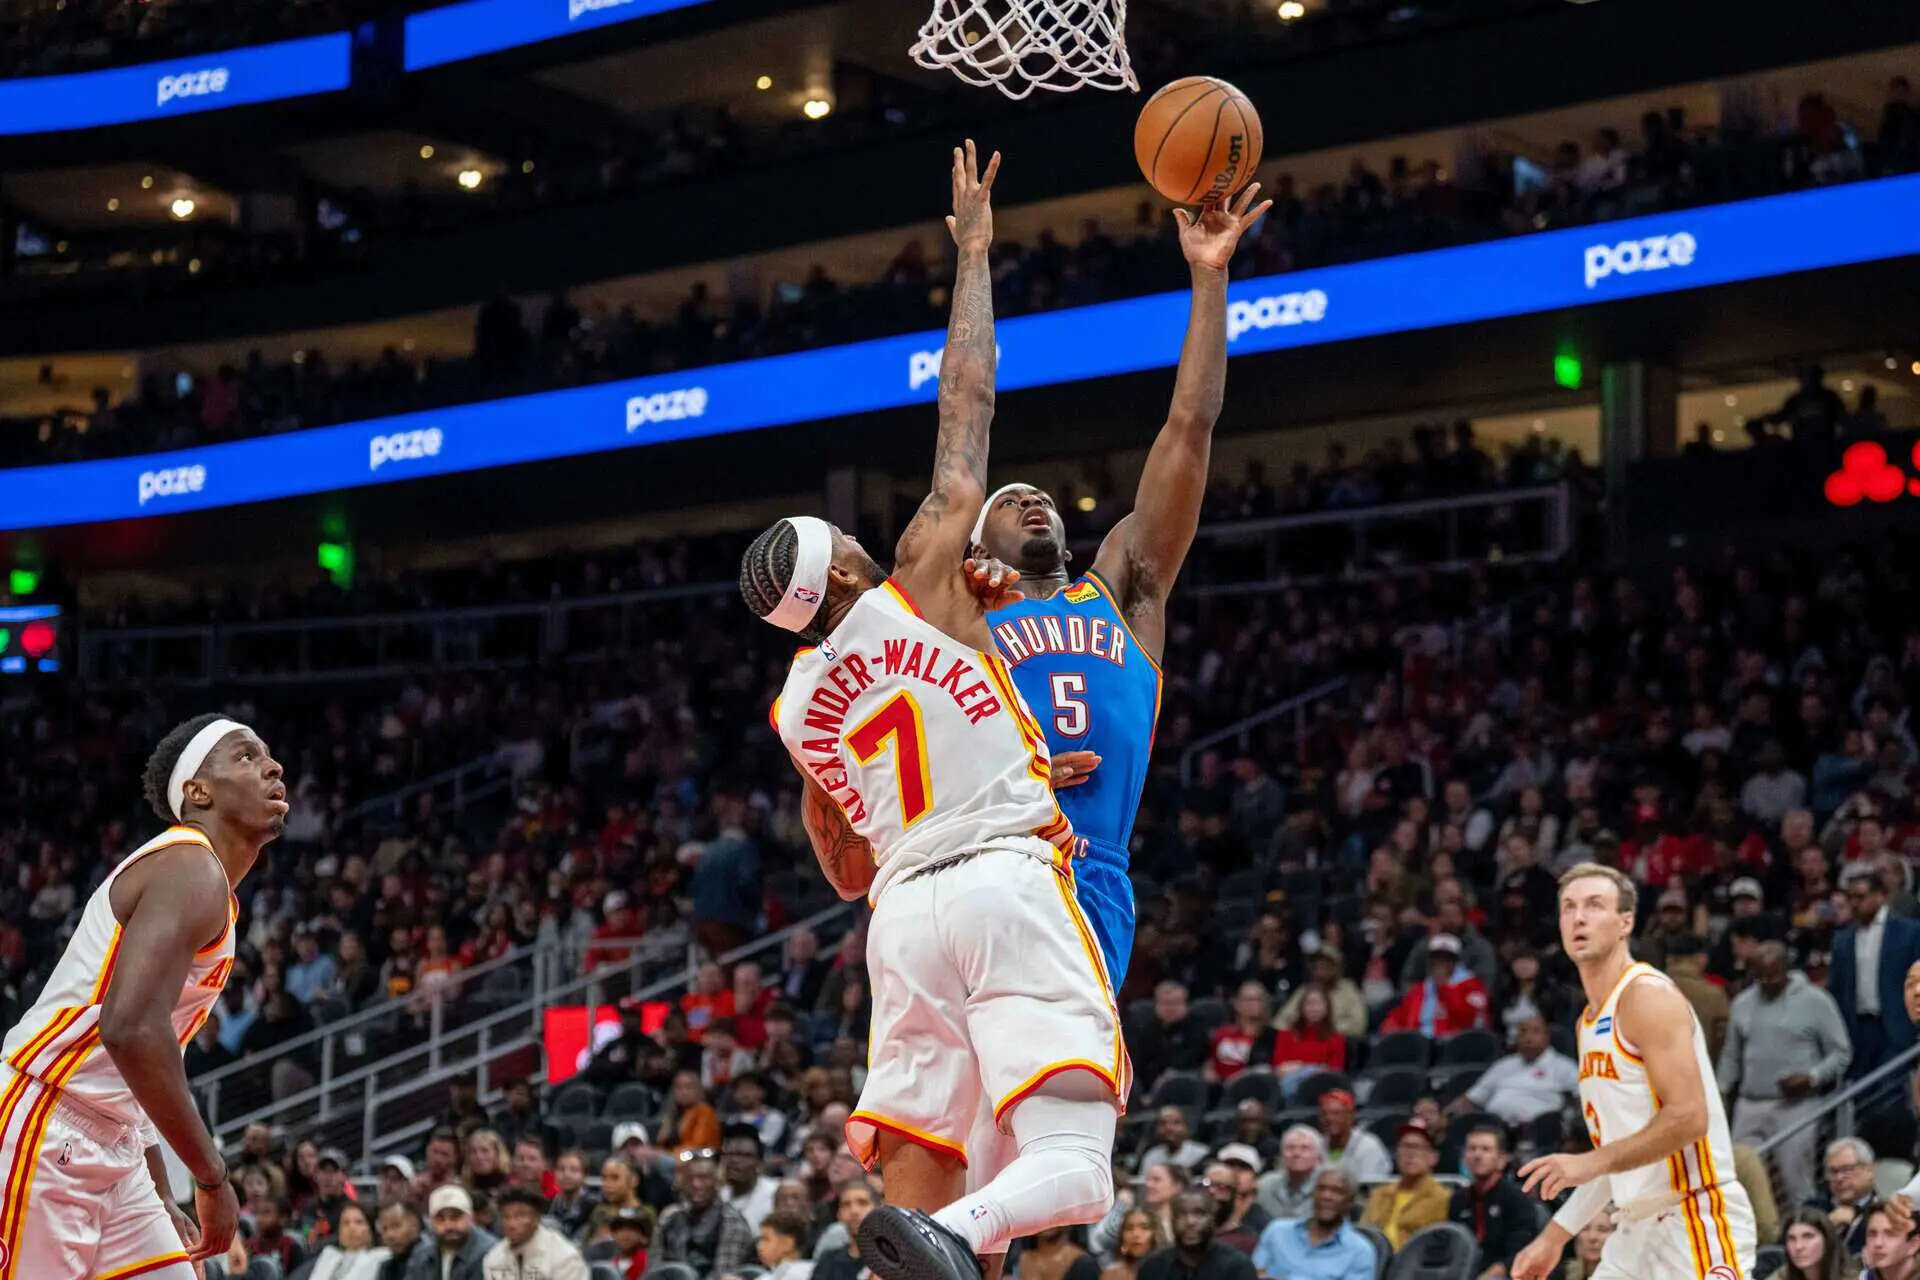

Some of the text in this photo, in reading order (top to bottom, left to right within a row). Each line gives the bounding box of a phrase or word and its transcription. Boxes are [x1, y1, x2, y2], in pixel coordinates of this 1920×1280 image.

[157, 67, 229, 106] paze
[1585, 232, 1697, 288] paze
[1227, 289, 1328, 342] paze
[626, 387, 708, 433] paze
[369, 427, 443, 472] paze
[138, 464, 206, 506] paze
[801, 638, 1000, 825] ALEXANDER-WALKER
[1049, 672, 1090, 738] 5
[843, 689, 934, 829] 7
